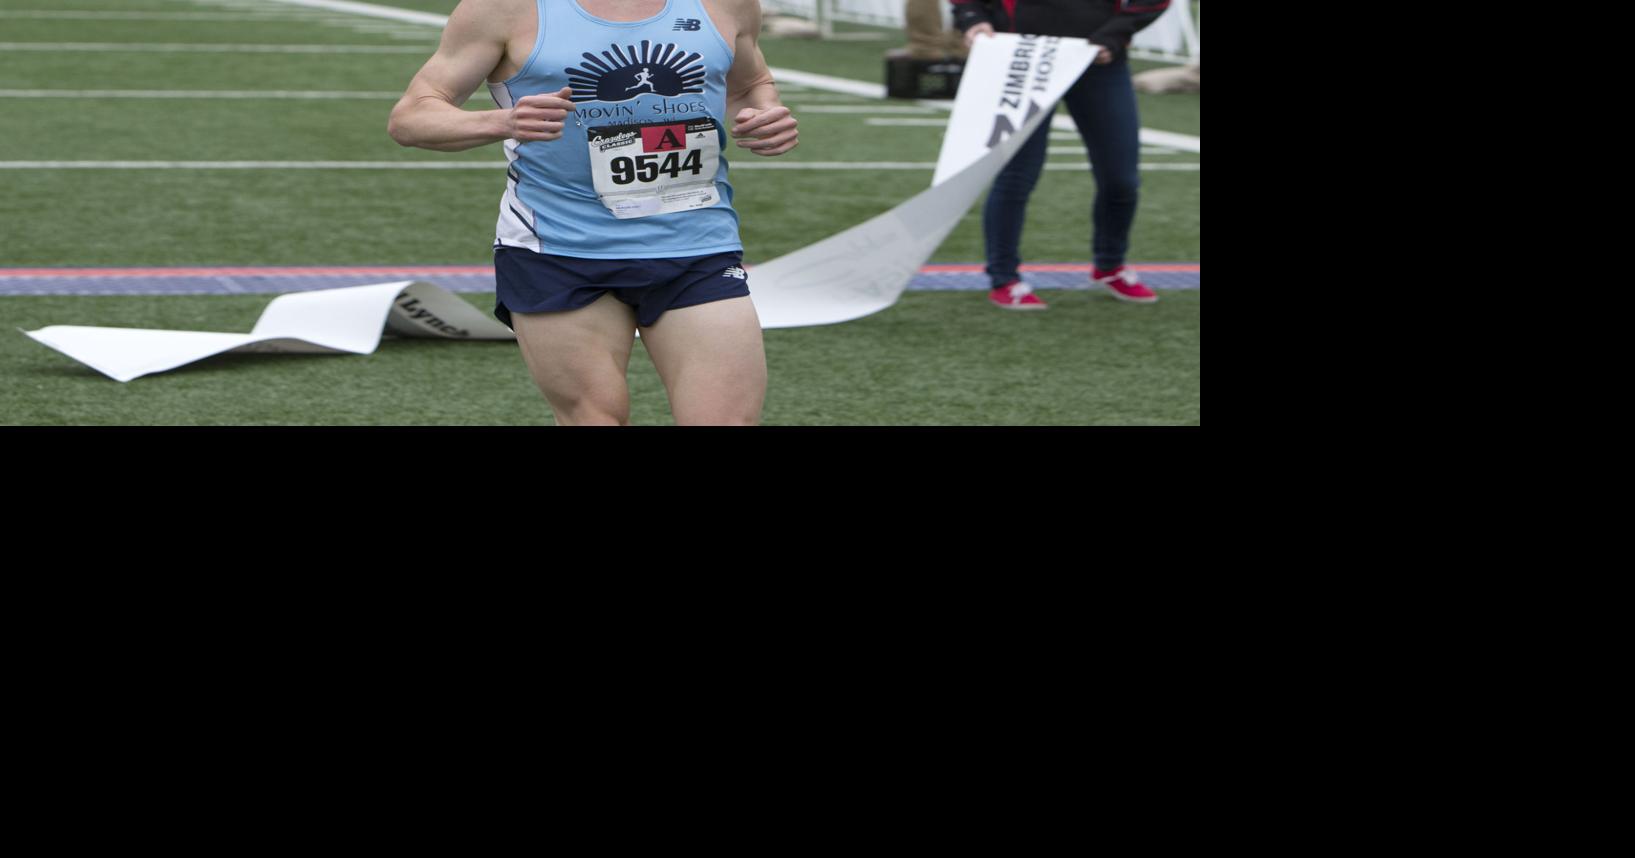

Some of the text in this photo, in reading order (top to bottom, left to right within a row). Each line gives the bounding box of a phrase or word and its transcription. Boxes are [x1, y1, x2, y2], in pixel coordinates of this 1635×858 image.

[672, 18, 701, 31] NB
[652, 98, 706, 114] SHOES
[601, 139, 634, 150] CLASSIC
[655, 128, 685, 149] A
[610, 149, 703, 185] 9544
